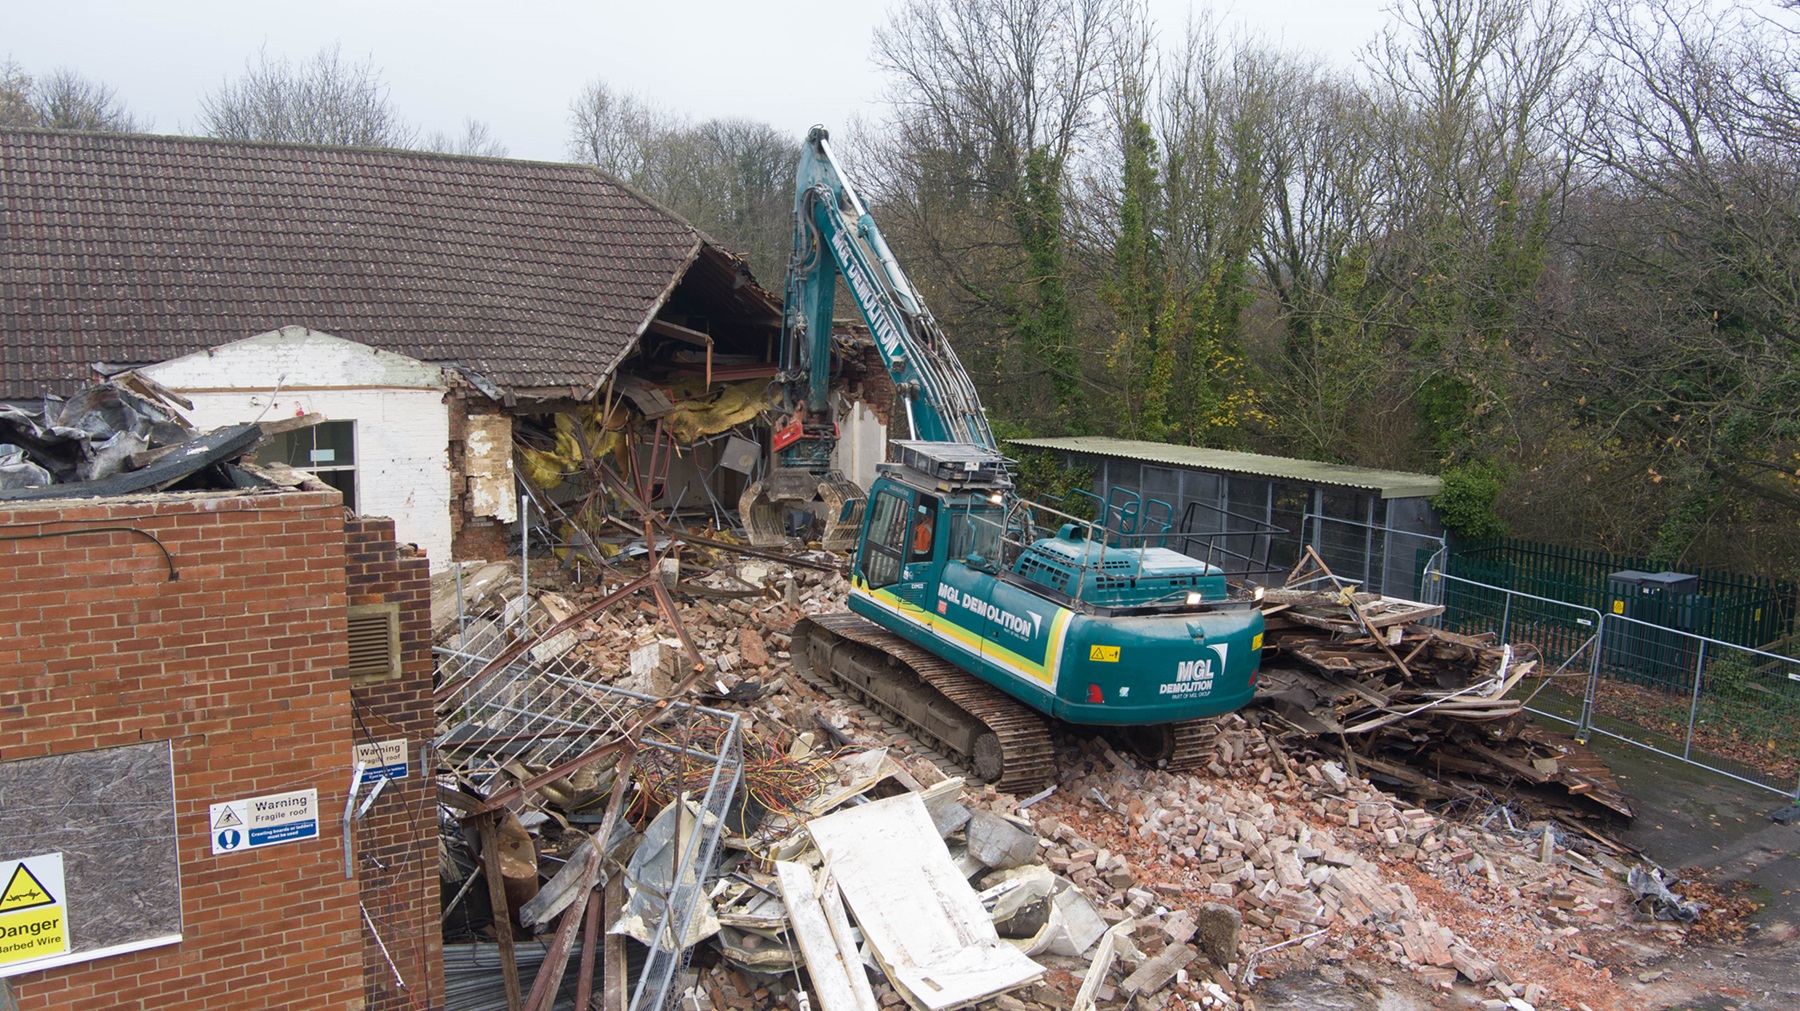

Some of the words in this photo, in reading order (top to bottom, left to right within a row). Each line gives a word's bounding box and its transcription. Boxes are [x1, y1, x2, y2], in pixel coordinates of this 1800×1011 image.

[832, 233, 850, 268] MGL
[847, 263, 900, 357] DEMOLITION
[937, 582, 960, 605] MGL
[962, 593, 1032, 638] DEMOLITION
[1176, 659, 1214, 682] MGL
[1159, 680, 1213, 694] DEMOLITION
[360, 745, 400, 756] Warning
[255, 797, 307, 811] Warning
[255, 812, 286, 822] Fragile
[289, 807, 307, 816] roof
[36, 936, 61, 946] Wire
